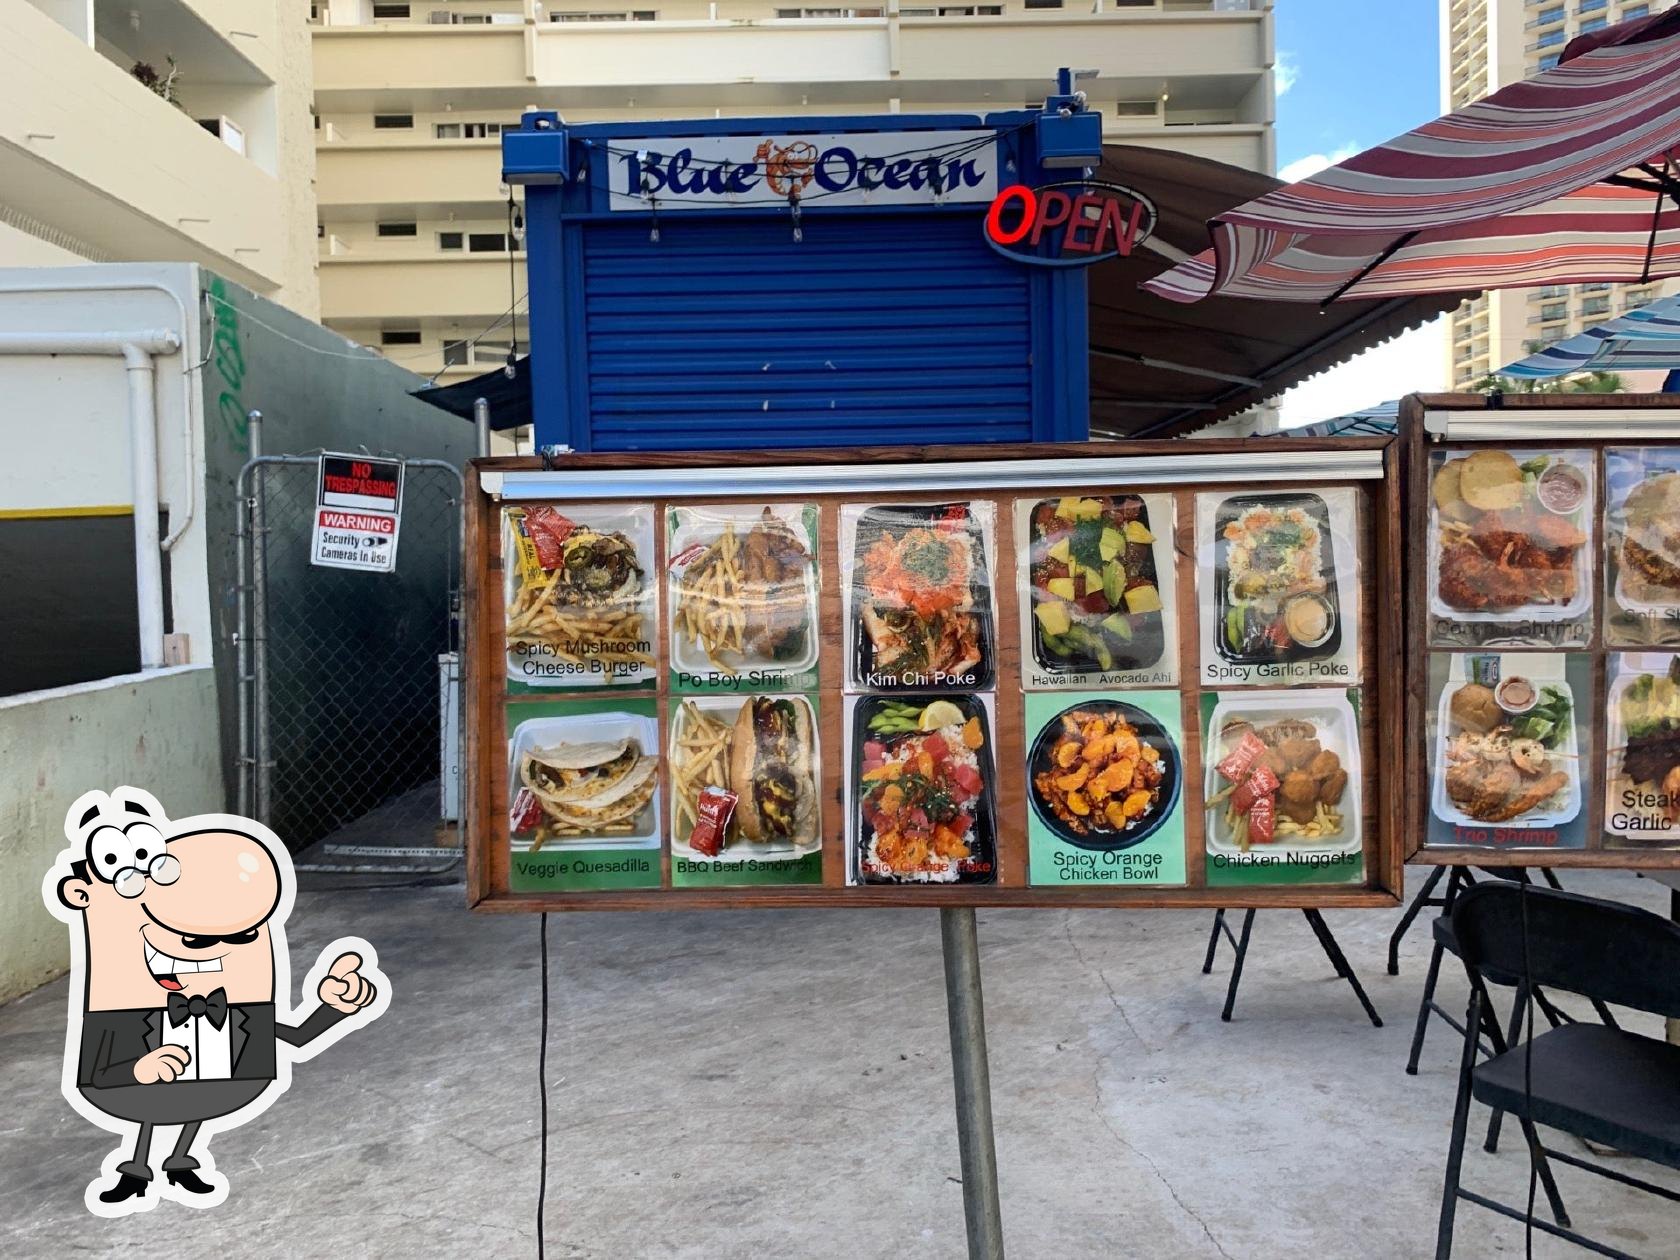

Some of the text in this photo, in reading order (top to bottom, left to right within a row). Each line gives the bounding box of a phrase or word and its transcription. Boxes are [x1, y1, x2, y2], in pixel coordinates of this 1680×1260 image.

[619, 146, 986, 196] Blue Ocean
[987, 184, 1143, 256] OPEN
[352, 462, 371, 477] NO
[325, 476, 396, 497] TRESPASSING
[324, 513, 391, 532] WARNING
[323, 532, 360, 549] Security
[321, 547, 386, 564] Cameras In Use
[516, 639, 650, 657] Spicy Mushroom
[522, 660, 646, 678] Cheese Burger
[1098, 673, 1149, 684] Avocado
[1152, 672, 1171, 683] Ahi
[1207, 662, 1349, 681] Spicy Garlic Poke
[679, 672, 703, 687] Po
[709, 671, 742, 690] Boy
[866, 671, 976, 687] Kim Chi Poke
[1622, 789, 1680, 808] Steak
[1612, 813, 1671, 830] Garlic
[1494, 828, 1559, 846] Shrimp
[677, 861, 709, 873] BBQ
[713, 860, 744, 872] Beef
[1053, 850, 1163, 868] Spicy Orange
[1213, 852, 1356, 869] Chicken Nuggets
[517, 859, 650, 878] Veggie Quesadilla
[1059, 866, 1159, 880] Chicken Bowl
